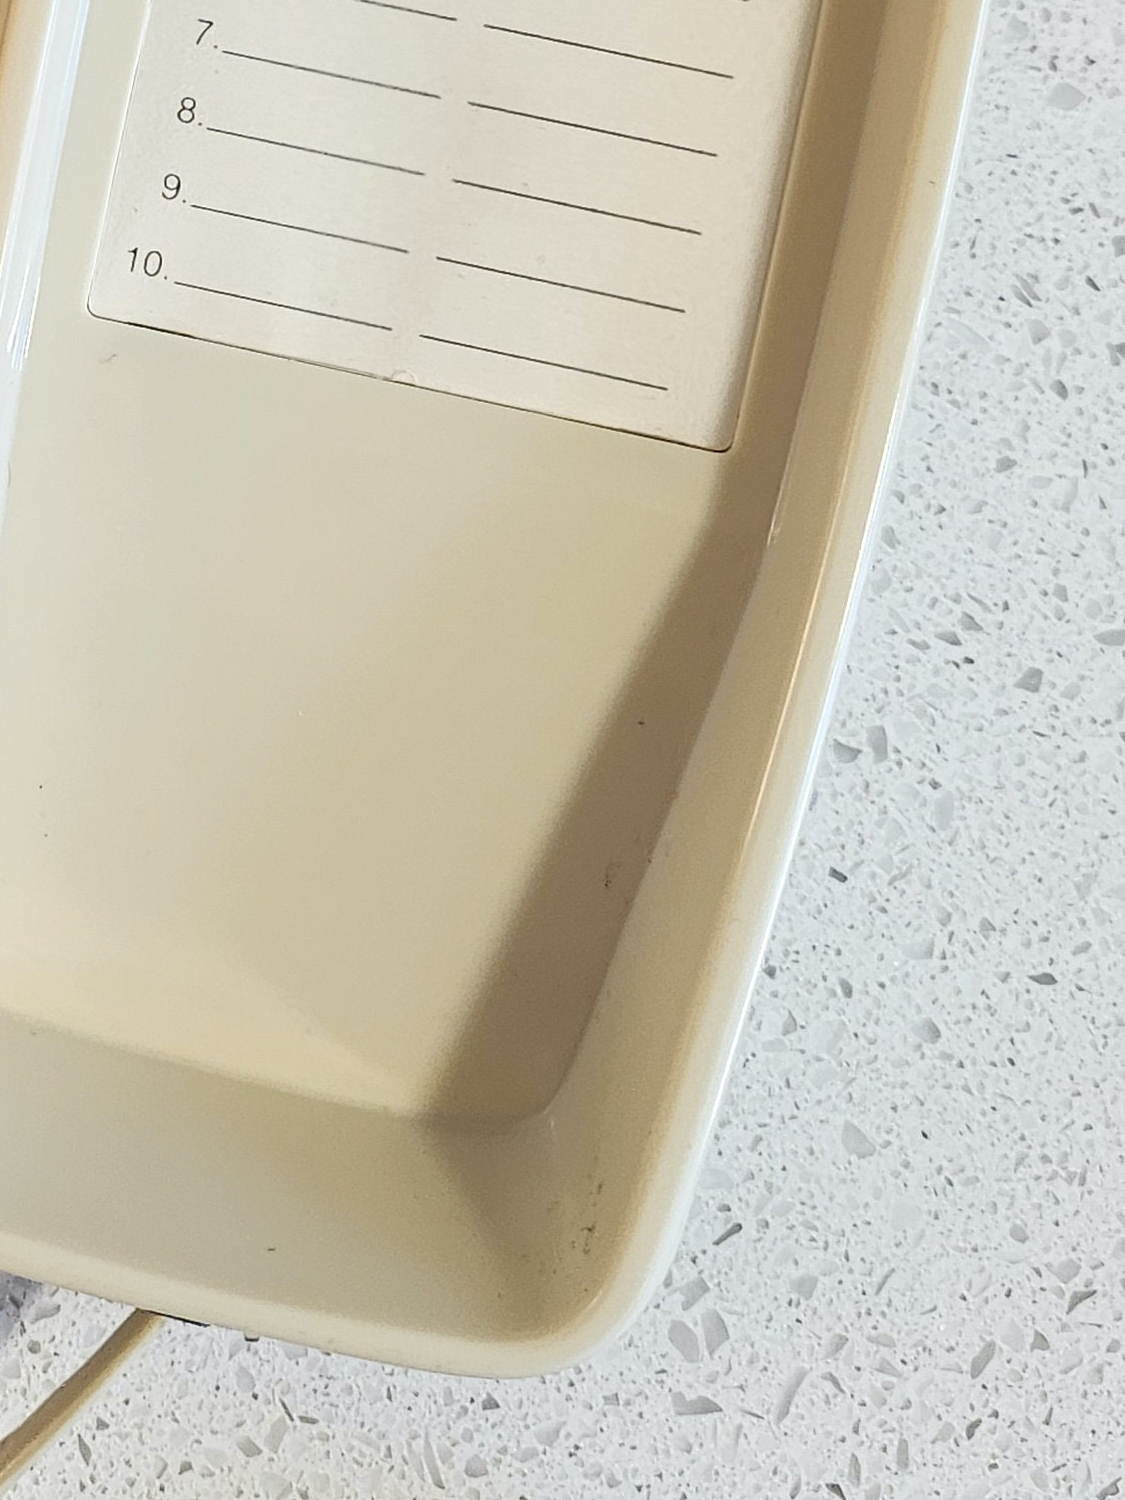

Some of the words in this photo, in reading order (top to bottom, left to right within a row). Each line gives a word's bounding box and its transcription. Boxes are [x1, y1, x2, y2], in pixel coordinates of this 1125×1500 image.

[196, 19, 218, 49] 7.
[176, 97, 202, 126] 8.
[161, 174, 186, 202] 9.
[126, 247, 168, 280] 10.
